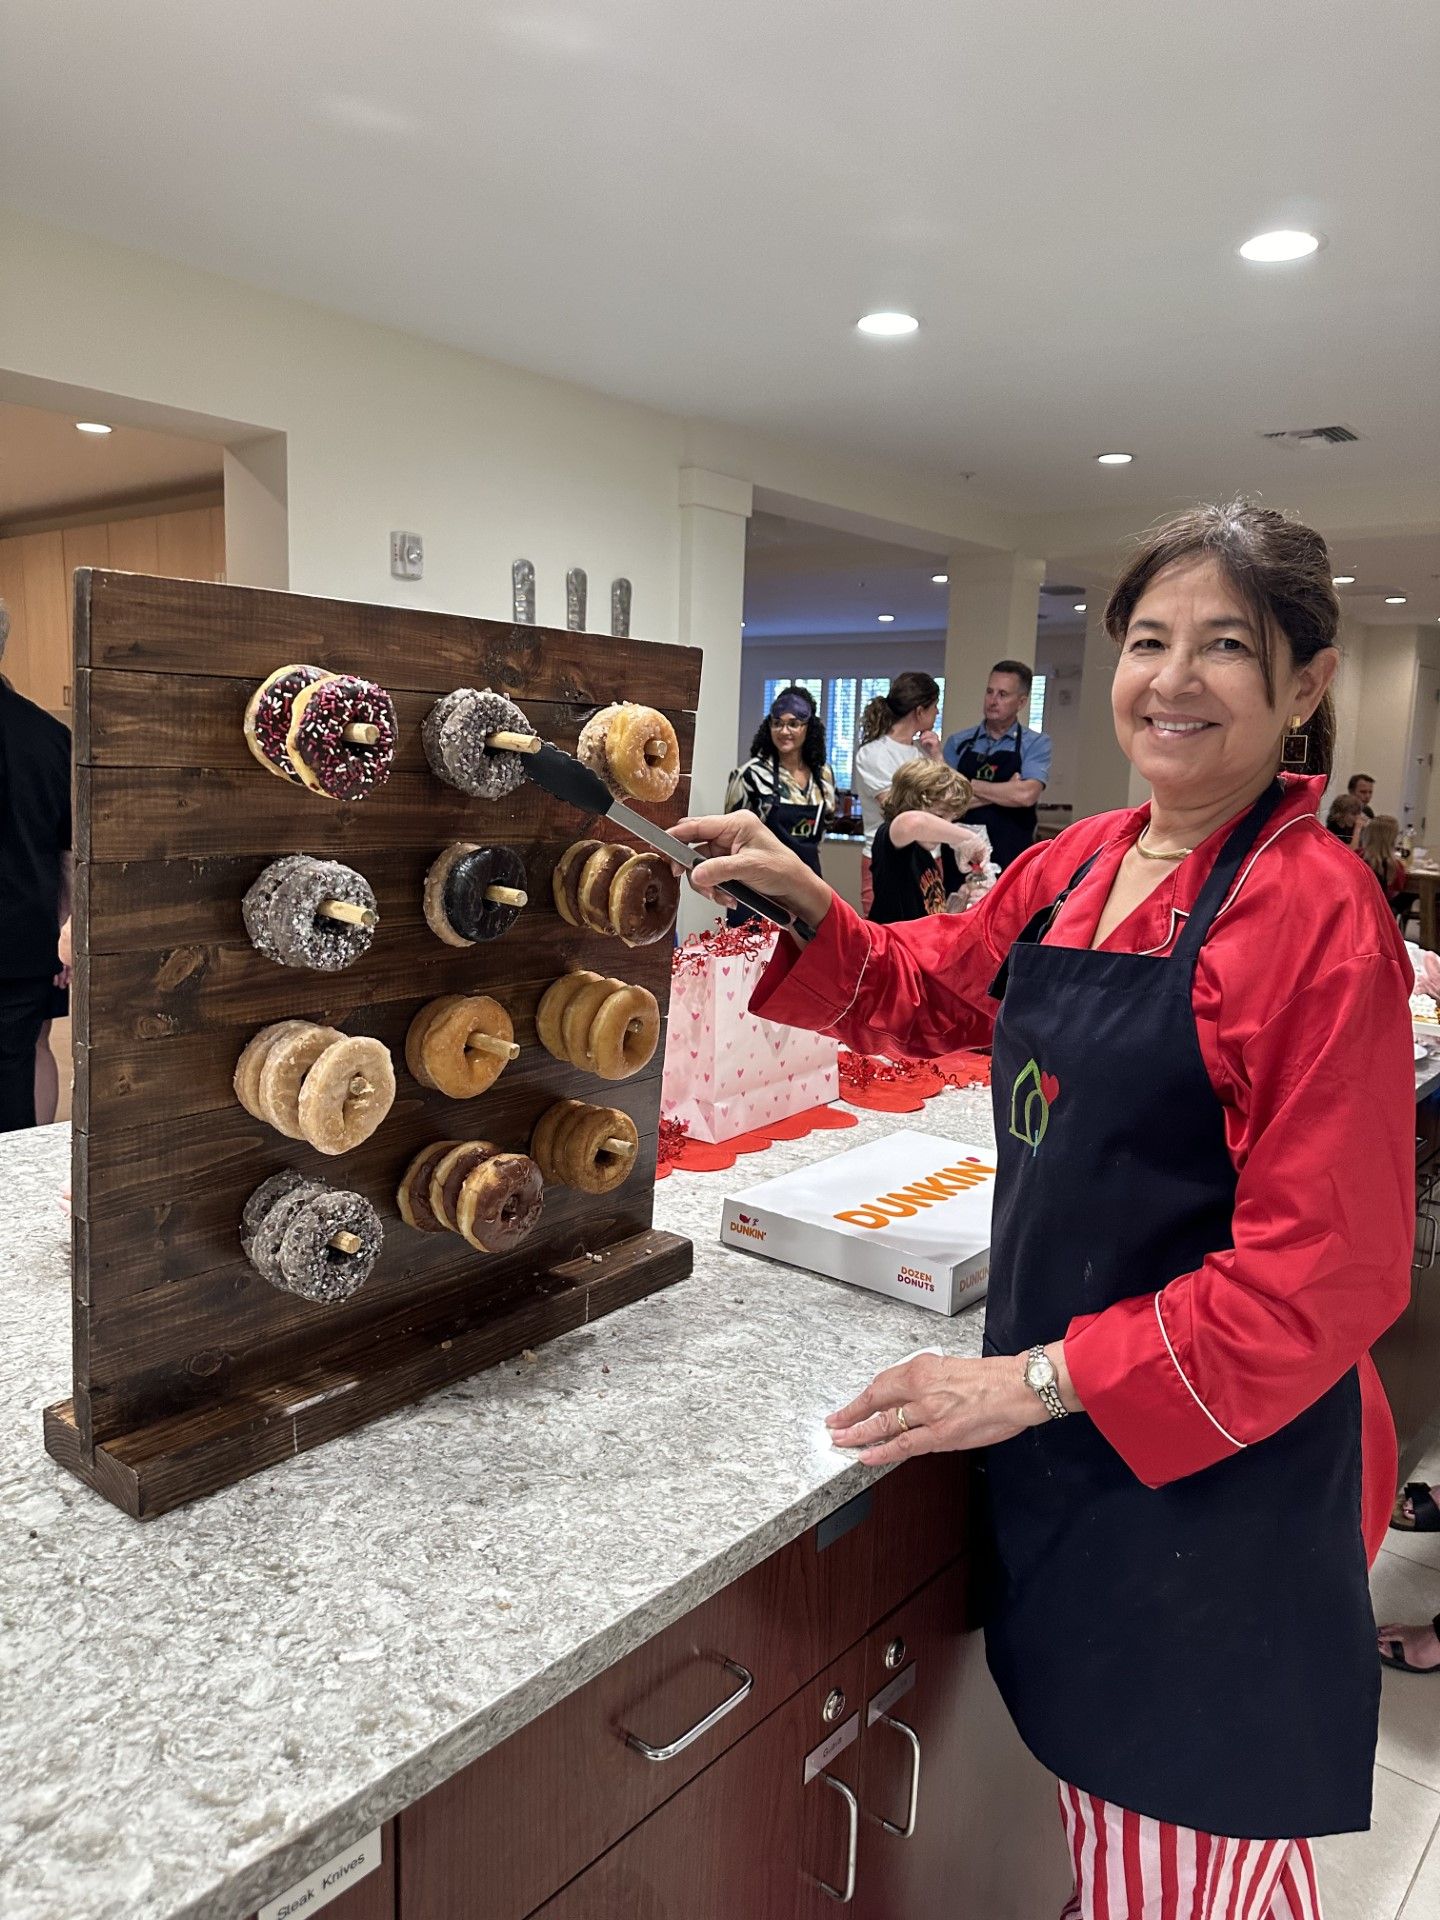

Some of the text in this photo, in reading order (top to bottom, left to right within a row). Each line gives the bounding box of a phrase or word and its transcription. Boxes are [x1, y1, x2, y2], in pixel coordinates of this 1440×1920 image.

[833, 1156, 997, 1229] DUNKIN'
[730, 1221, 767, 1241] DUNKIN'
[897, 1274, 935, 1292] DONUTS
[901, 1266, 932, 1282] DOZEN
[277, 1853, 366, 1920] Steak Knives
